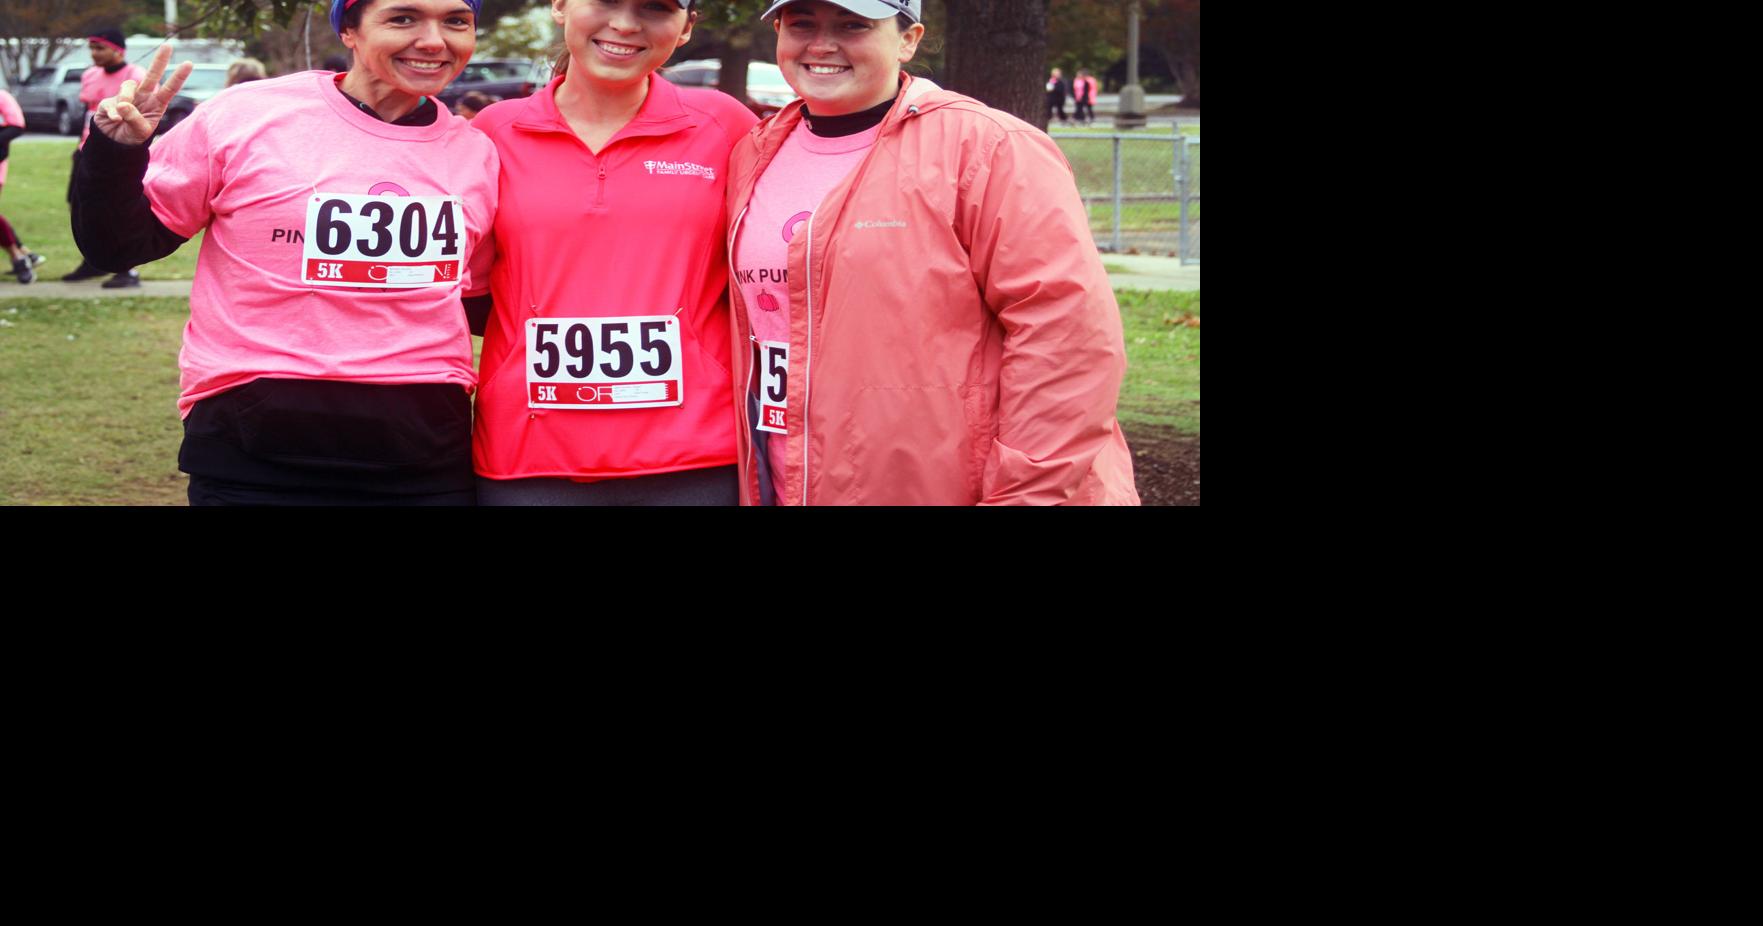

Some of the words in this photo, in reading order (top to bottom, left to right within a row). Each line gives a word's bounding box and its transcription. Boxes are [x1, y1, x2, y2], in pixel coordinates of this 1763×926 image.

[272, 229, 305, 244] PIN
[316, 199, 459, 257] 6304
[317, 262, 344, 279] 5K
[533, 321, 672, 378] 5955
[767, 347, 788, 402] 5
[538, 385, 557, 401] 5K
[769, 409, 785, 426] 5K
